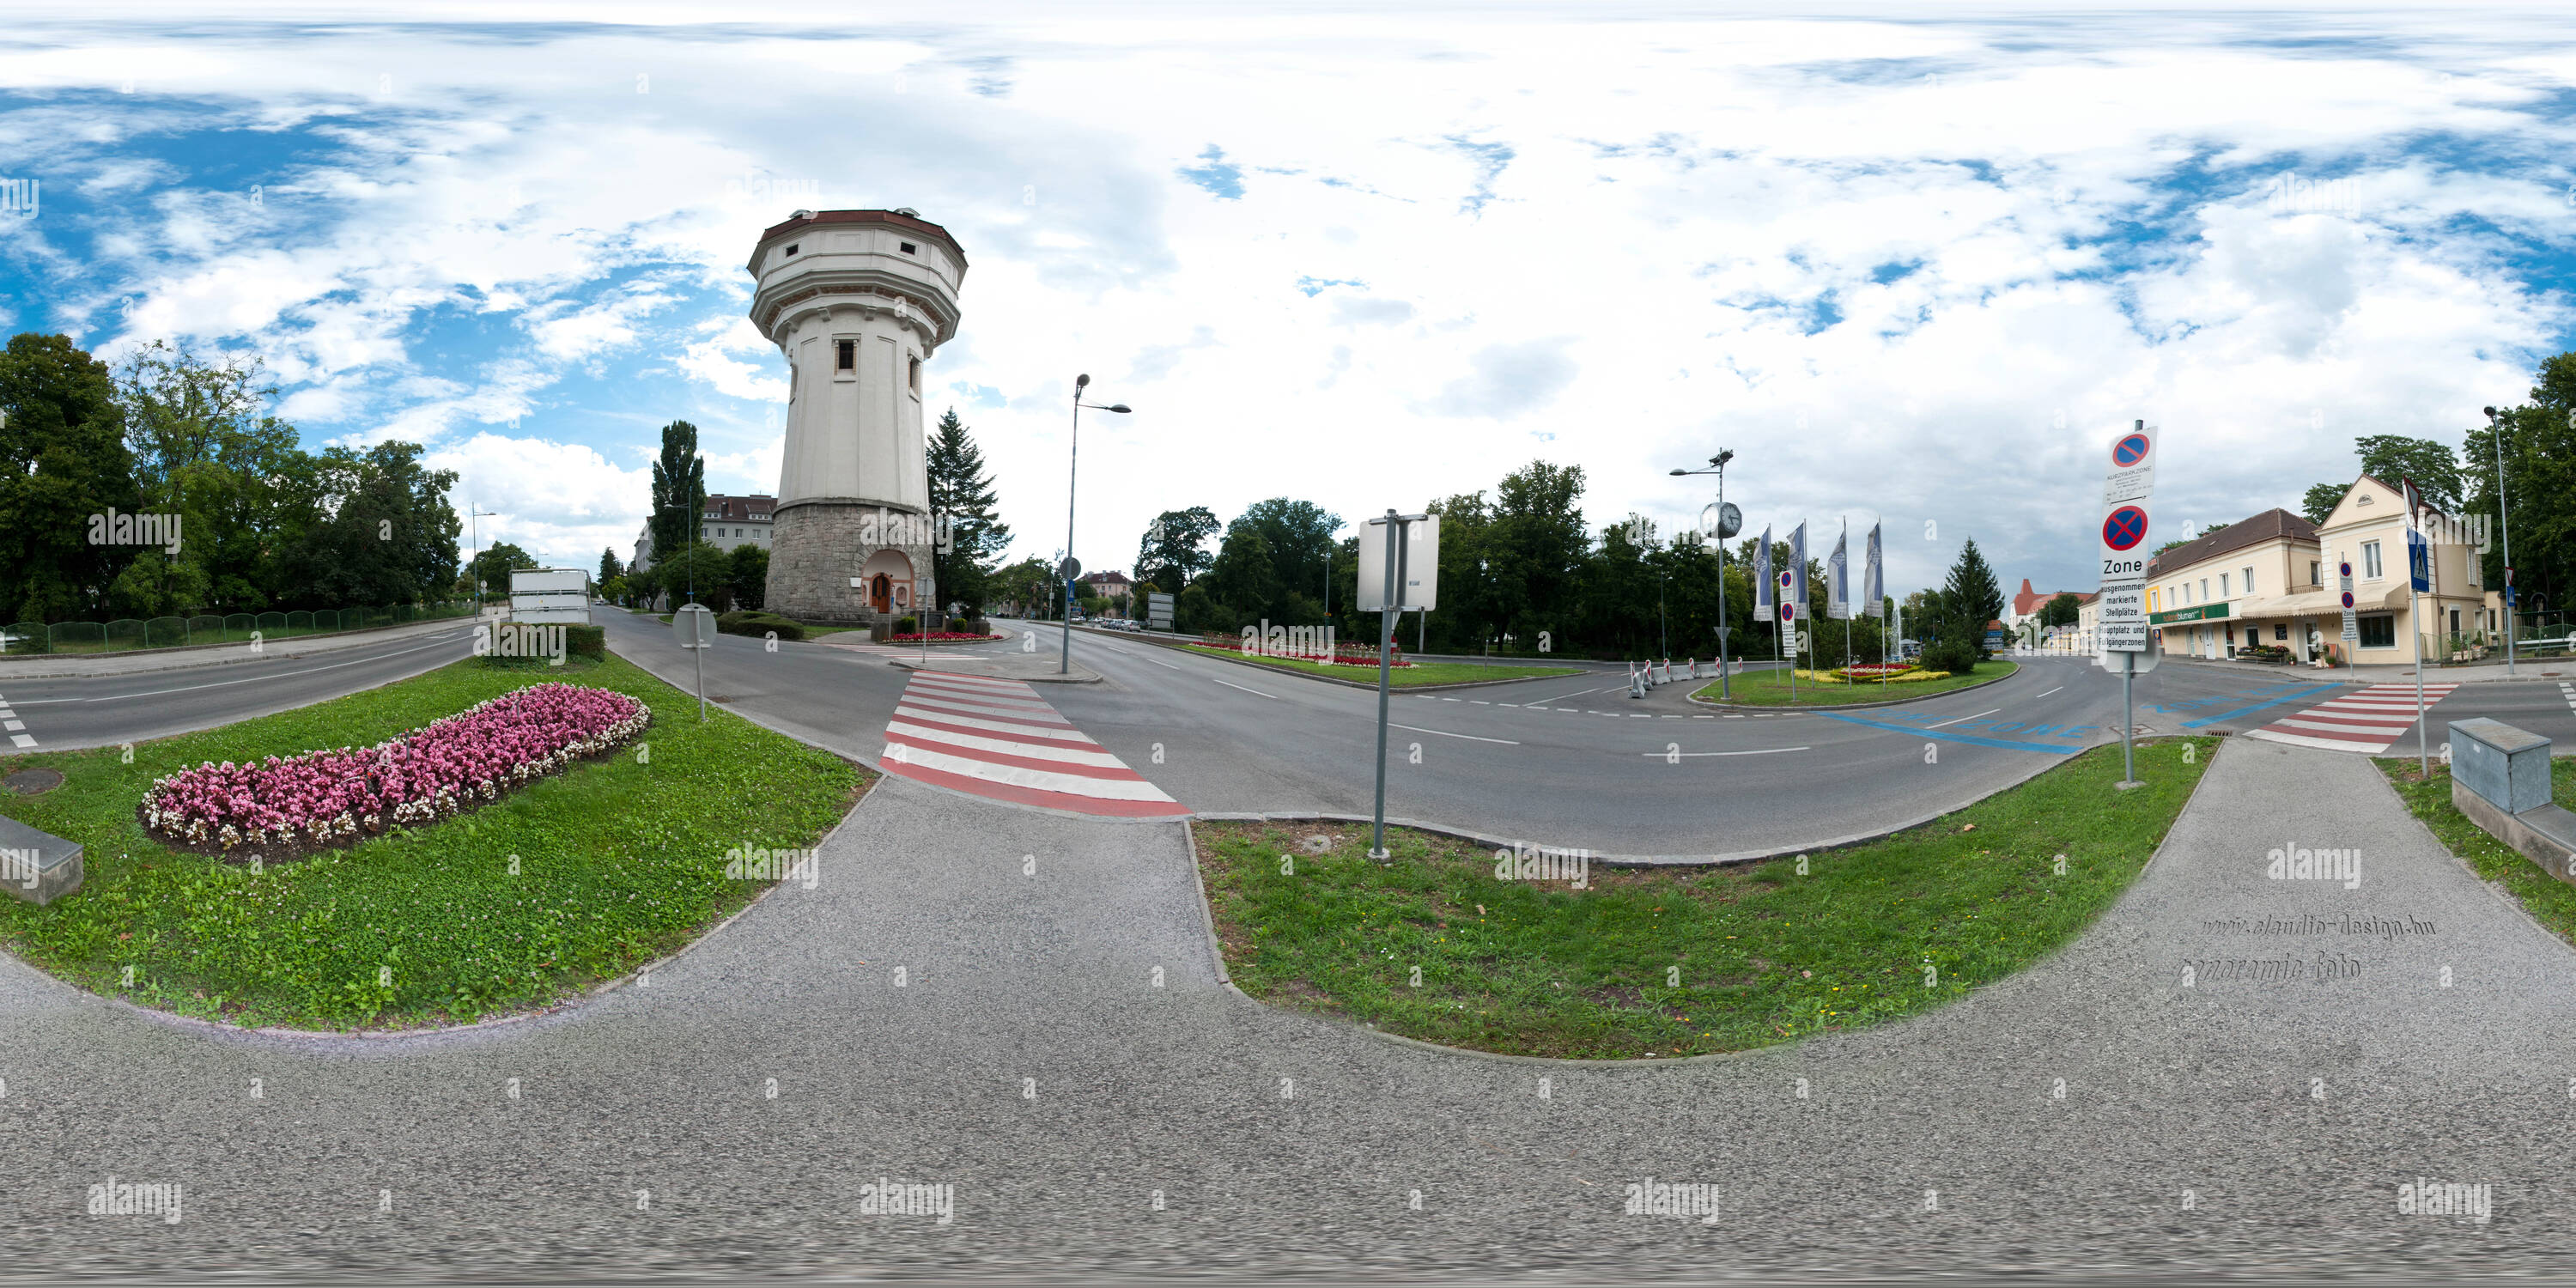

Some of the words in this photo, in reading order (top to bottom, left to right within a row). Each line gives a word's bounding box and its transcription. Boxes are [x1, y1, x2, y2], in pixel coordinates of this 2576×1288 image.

[2104, 560, 2142, 574] Zone
[2101, 583, 2145, 594] ausgenommen
[2106, 595, 2137, 605] markierte
[2105, 608, 2138, 618] Stellplätze
[2099, 626, 2129, 635] Hauptplatz
[2133, 625, 2145, 634] und
[2099, 637, 2145, 647] Fußgängerzonen
[1953, 720, 2099, 738] ZONE
